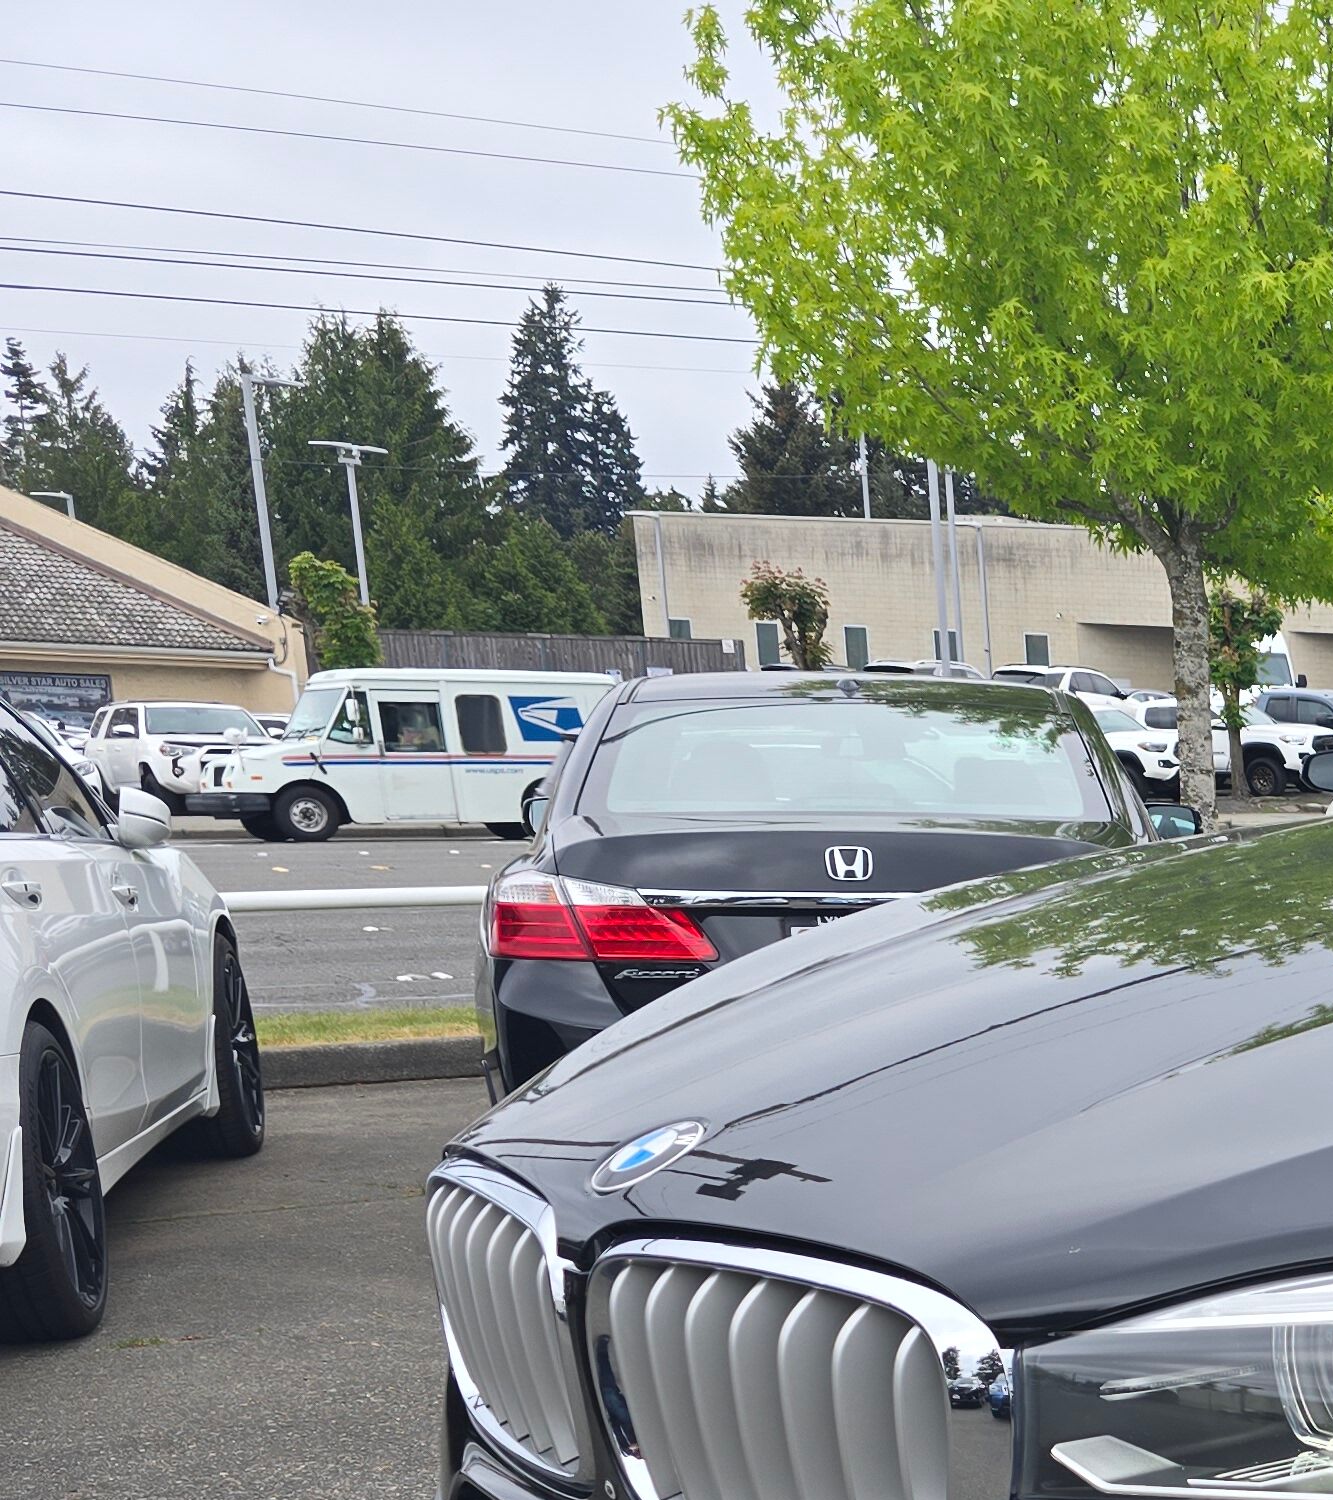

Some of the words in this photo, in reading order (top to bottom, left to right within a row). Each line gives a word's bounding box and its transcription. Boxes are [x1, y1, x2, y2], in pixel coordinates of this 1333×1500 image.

[0, 674, 29, 687] SILVER
[31, 676, 54, 687] STAR
[55, 677, 78, 688] AUTO
[79, 678, 106, 689] SALES
[614, 968, 700, 980] Accord
